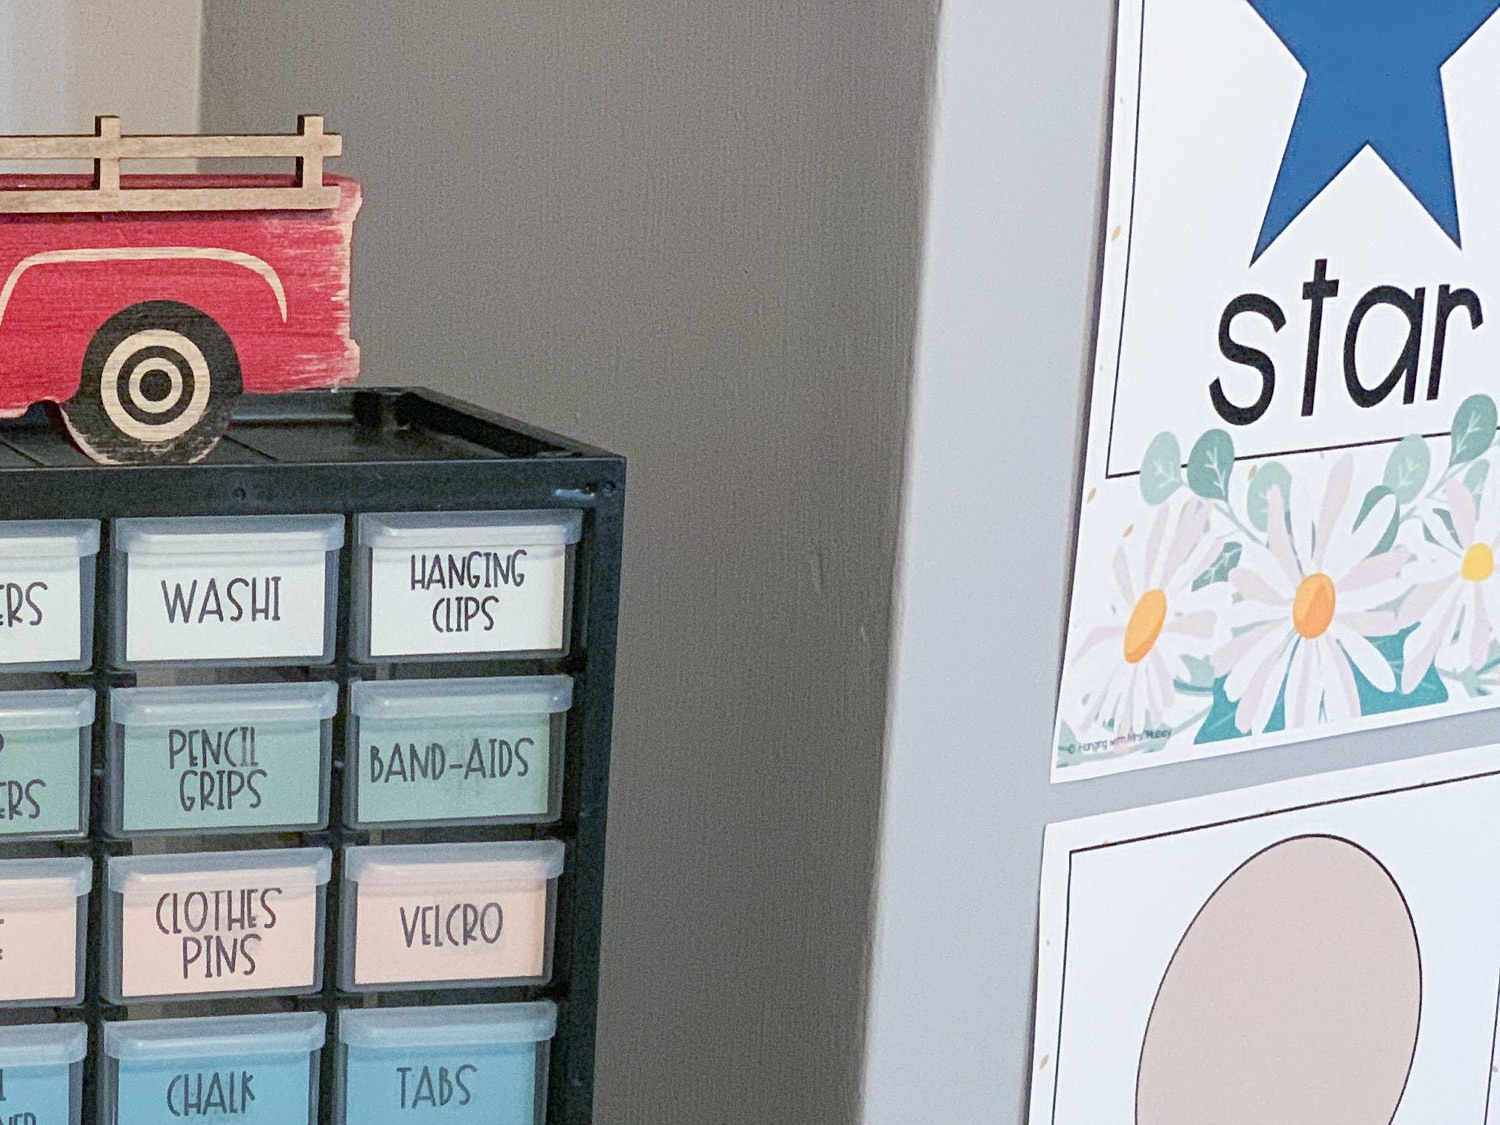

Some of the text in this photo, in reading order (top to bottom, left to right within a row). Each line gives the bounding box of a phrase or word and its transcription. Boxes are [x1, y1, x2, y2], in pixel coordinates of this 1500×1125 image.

[1208, 258, 1484, 425] star
[411, 550, 527, 591] HANGING
[161, 576, 281, 624] WASHI
[432, 597, 499, 633] CLIPS
[169, 728, 258, 770] PENCIL
[370, 736, 535, 784] BAND-AIDS
[179, 769, 266, 812] GRIPS
[156, 887, 282, 934] CLOTHES
[400, 902, 503, 949] VELCRO
[182, 935, 261, 979] PINS
[167, 1071, 255, 1118] CHALK
[397, 1065, 478, 1109] TABS
